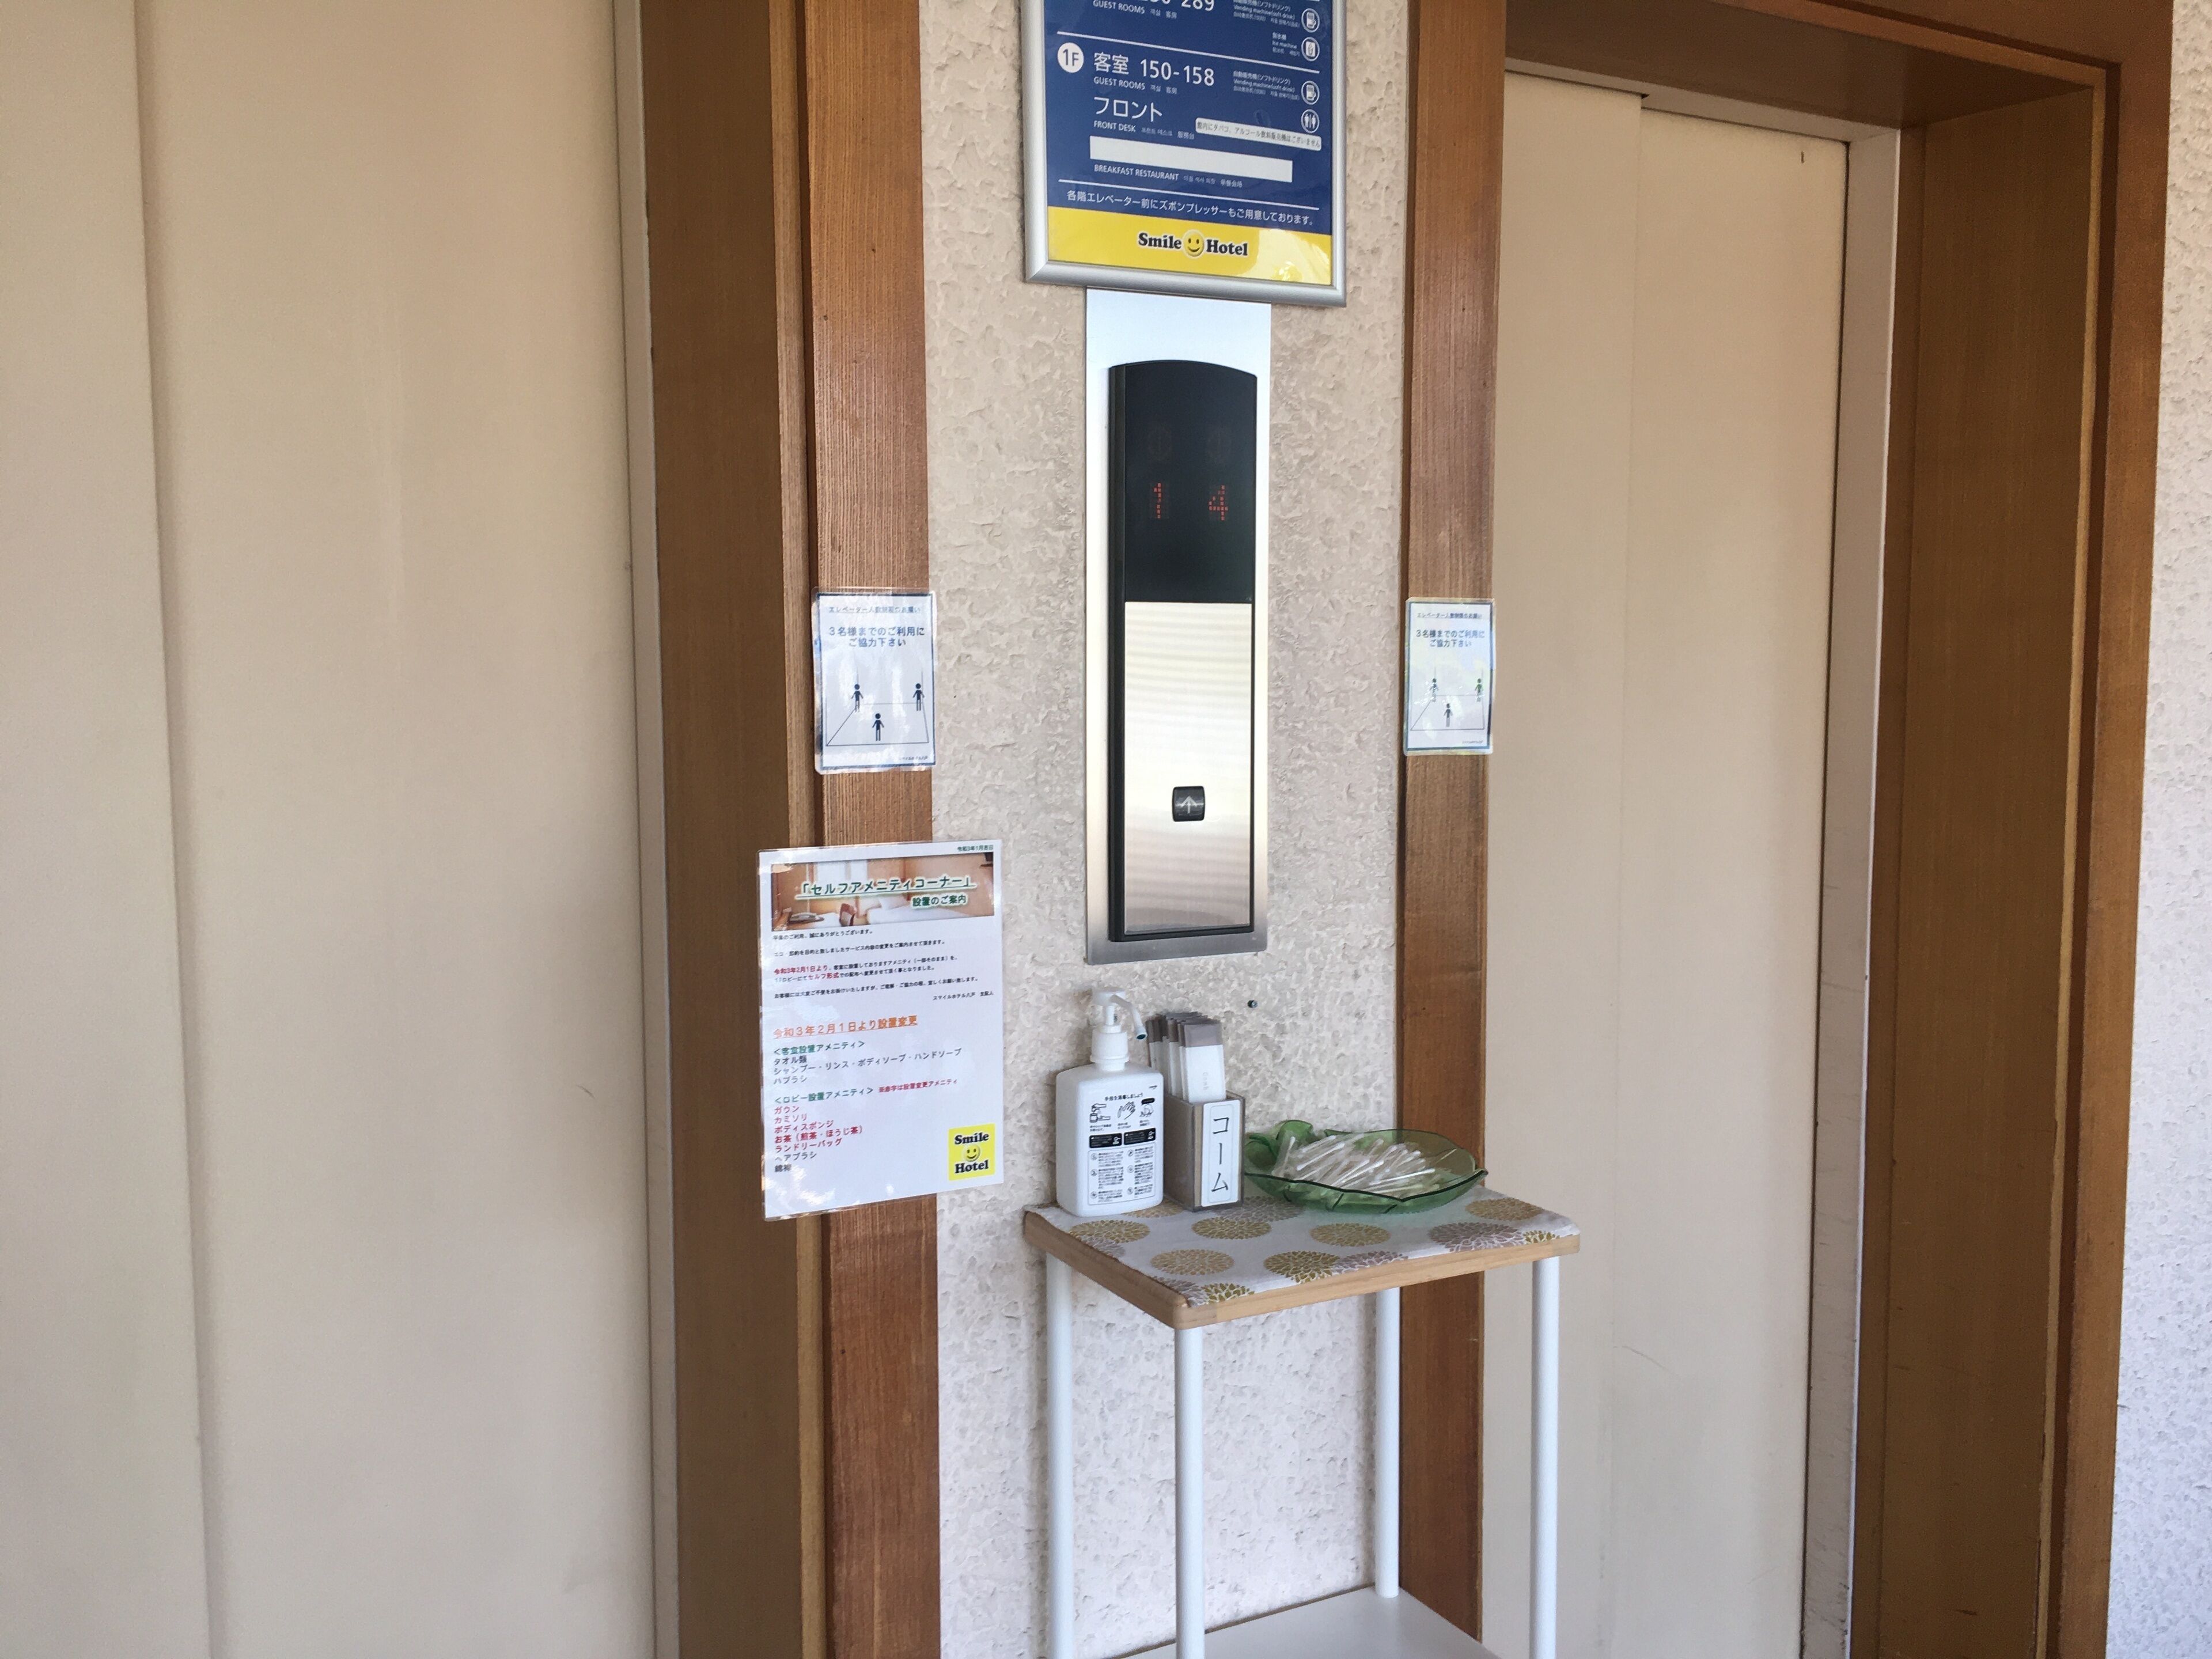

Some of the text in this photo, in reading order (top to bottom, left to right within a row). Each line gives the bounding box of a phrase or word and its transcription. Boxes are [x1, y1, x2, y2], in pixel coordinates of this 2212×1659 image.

[1093, 0, 1116, 9] GUEST
[1118, 3, 1145, 14] ROOMS
[1062, 48, 1079, 67] 1F
[1094, 52, 1215, 86] 客室 150-158
[1094, 77, 1145, 90] GUEST ROOMS
[1094, 97, 1162, 122] フロント
[1094, 120, 1136, 133] FRONT DESK
[1094, 164, 1179, 181] BREAKFAST RESTAURANT
[1138, 232, 1248, 256] Smile Hotel
[1153, 483, 1162, 519] 1
[1209, 485, 1228, 520] 4
[849, 638, 906, 647] ご協力下さい
[802, 876, 972, 896] 「セルフアメニティコーナー」
[912, 895, 968, 907] 設置のご案内
[774, 1055, 807, 1066] タオル類
[774, 1075, 808, 1085] ハブラシ
[774, 1105, 800, 1115] ガウン
[774, 1113, 807, 1124] カミソリ
[774, 1120, 834, 1134] ボディスポンジ
[775, 1138, 842, 1153] ランドリーバッグ
[955, 1132, 989, 1145] Smile
[775, 1152, 817, 1162] ヘアブラシ
[1211, 1117, 1229, 1192] コーム
[955, 1160, 989, 1174] Hotel
